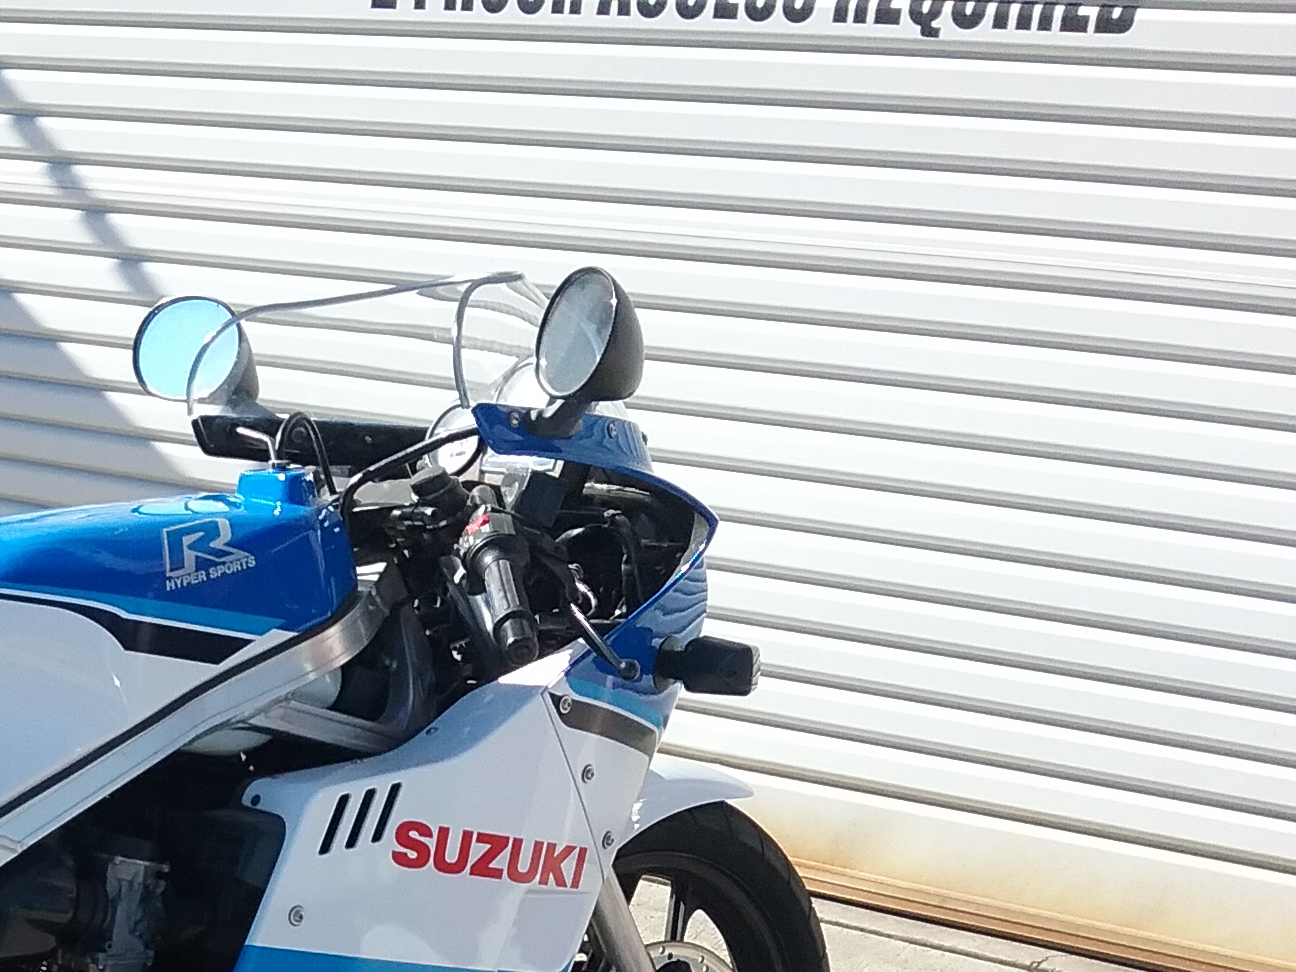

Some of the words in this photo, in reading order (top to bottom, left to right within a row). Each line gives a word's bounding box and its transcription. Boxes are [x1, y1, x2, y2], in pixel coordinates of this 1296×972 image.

[165, 570, 207, 591] HYPER
[209, 555, 256, 579] SPORTS
[391, 820, 589, 889] SUZUKI
